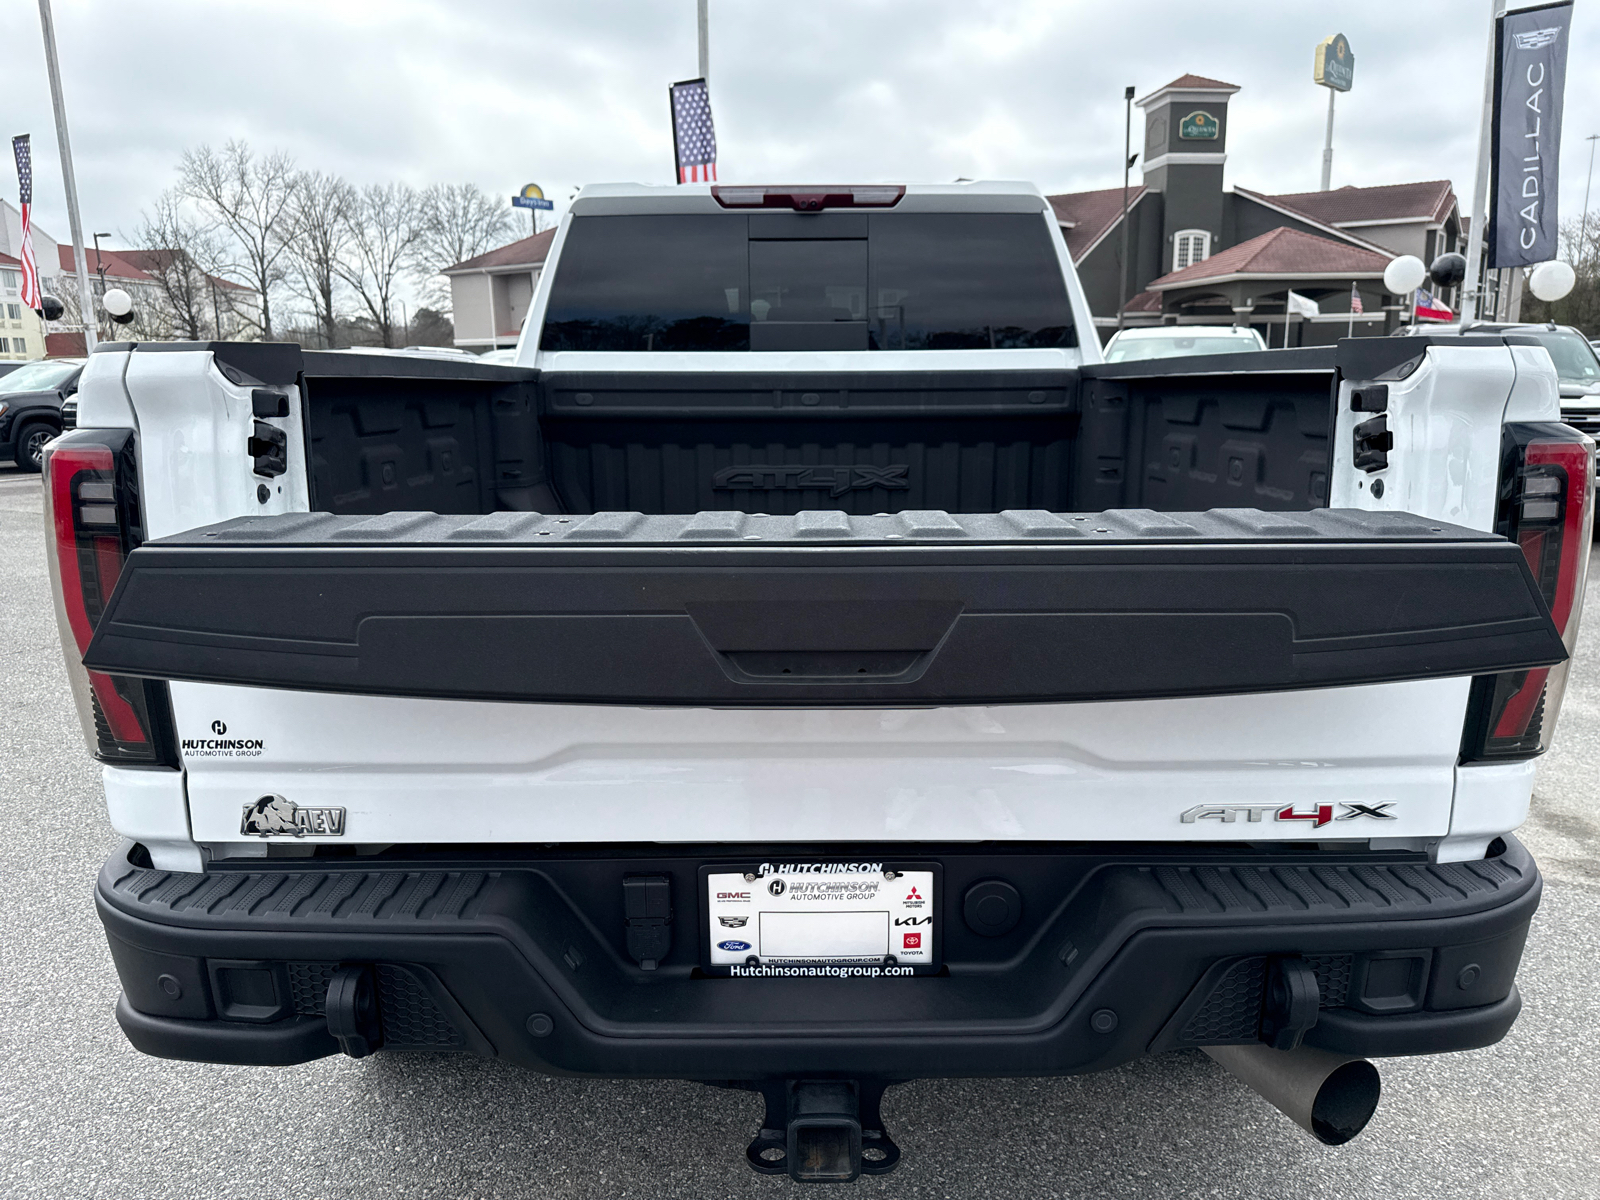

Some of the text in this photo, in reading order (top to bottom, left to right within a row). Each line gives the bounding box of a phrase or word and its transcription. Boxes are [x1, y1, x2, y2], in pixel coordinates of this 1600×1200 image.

[1519, 62, 1545, 250] CADILLAC
[712, 464, 909, 498] AT4X
[182, 740, 263, 749] HUTCHINSON
[1180, 800, 1398, 828] AT4X
[297, 810, 342, 834] AEV
[778, 863, 883, 875] HUTCHINSON
[789, 881, 880, 893] HUTCHINSON
[846, 892, 876, 900] GROUP
[895, 916, 932, 926] KIA
[723, 941, 745, 950] Ford
[730, 965, 914, 978] Hutchinsonautogroup.com
